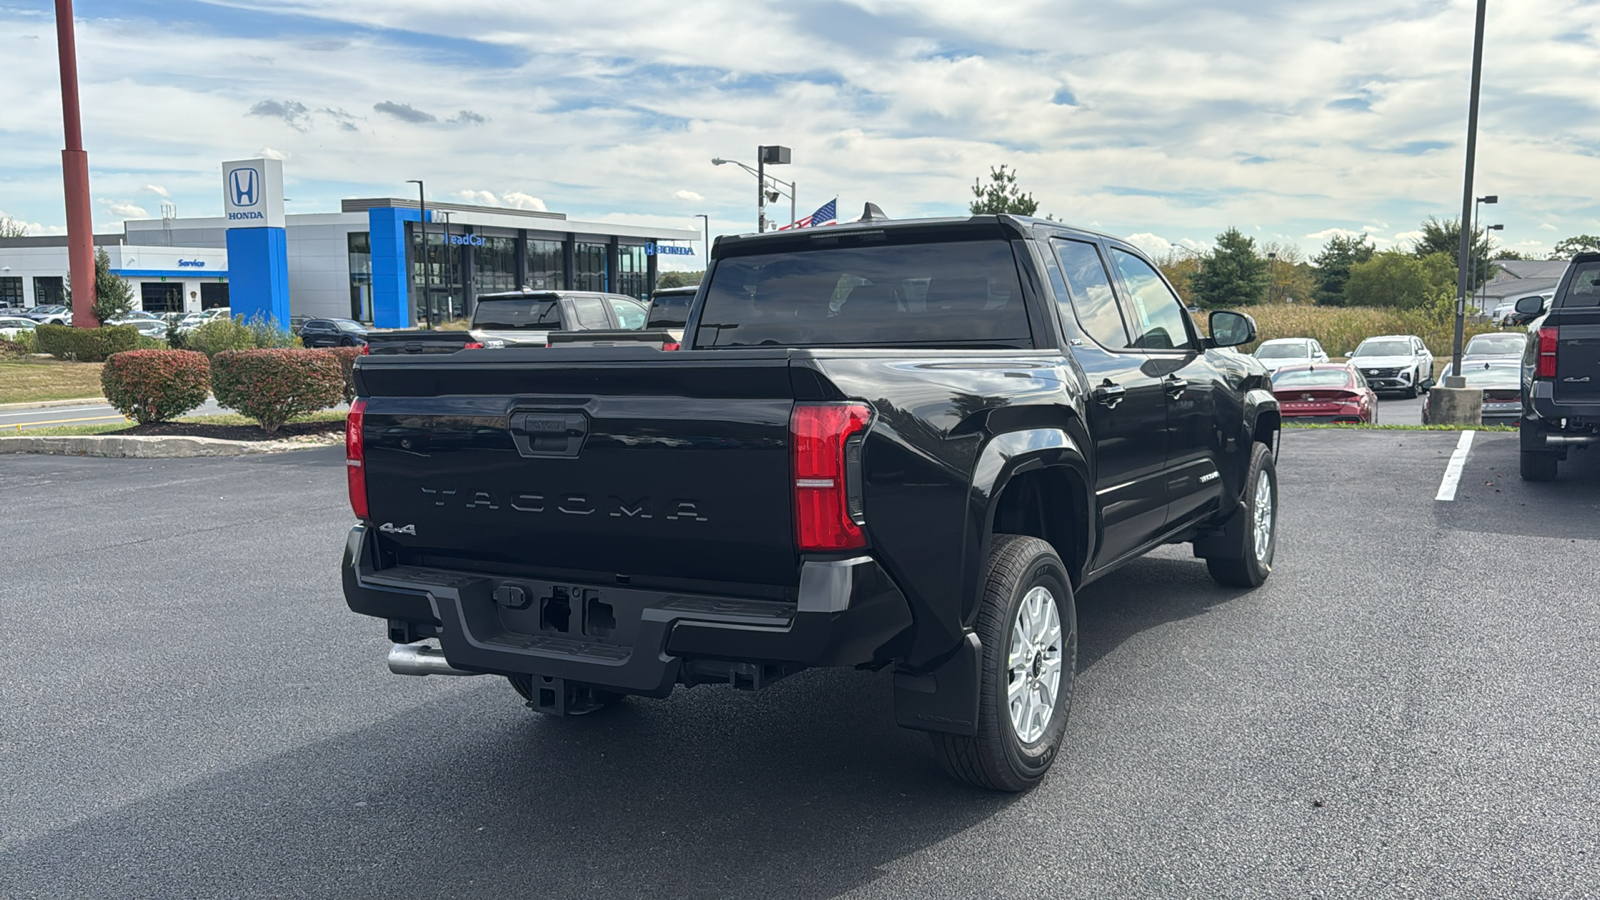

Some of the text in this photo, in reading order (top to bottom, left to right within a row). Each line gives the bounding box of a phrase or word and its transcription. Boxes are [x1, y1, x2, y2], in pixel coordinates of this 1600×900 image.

[228, 211, 264, 220] HONDA
[656, 245, 696, 256] HONDA
[178, 259, 205, 267] Service
[421, 486, 709, 522] TACOMA
